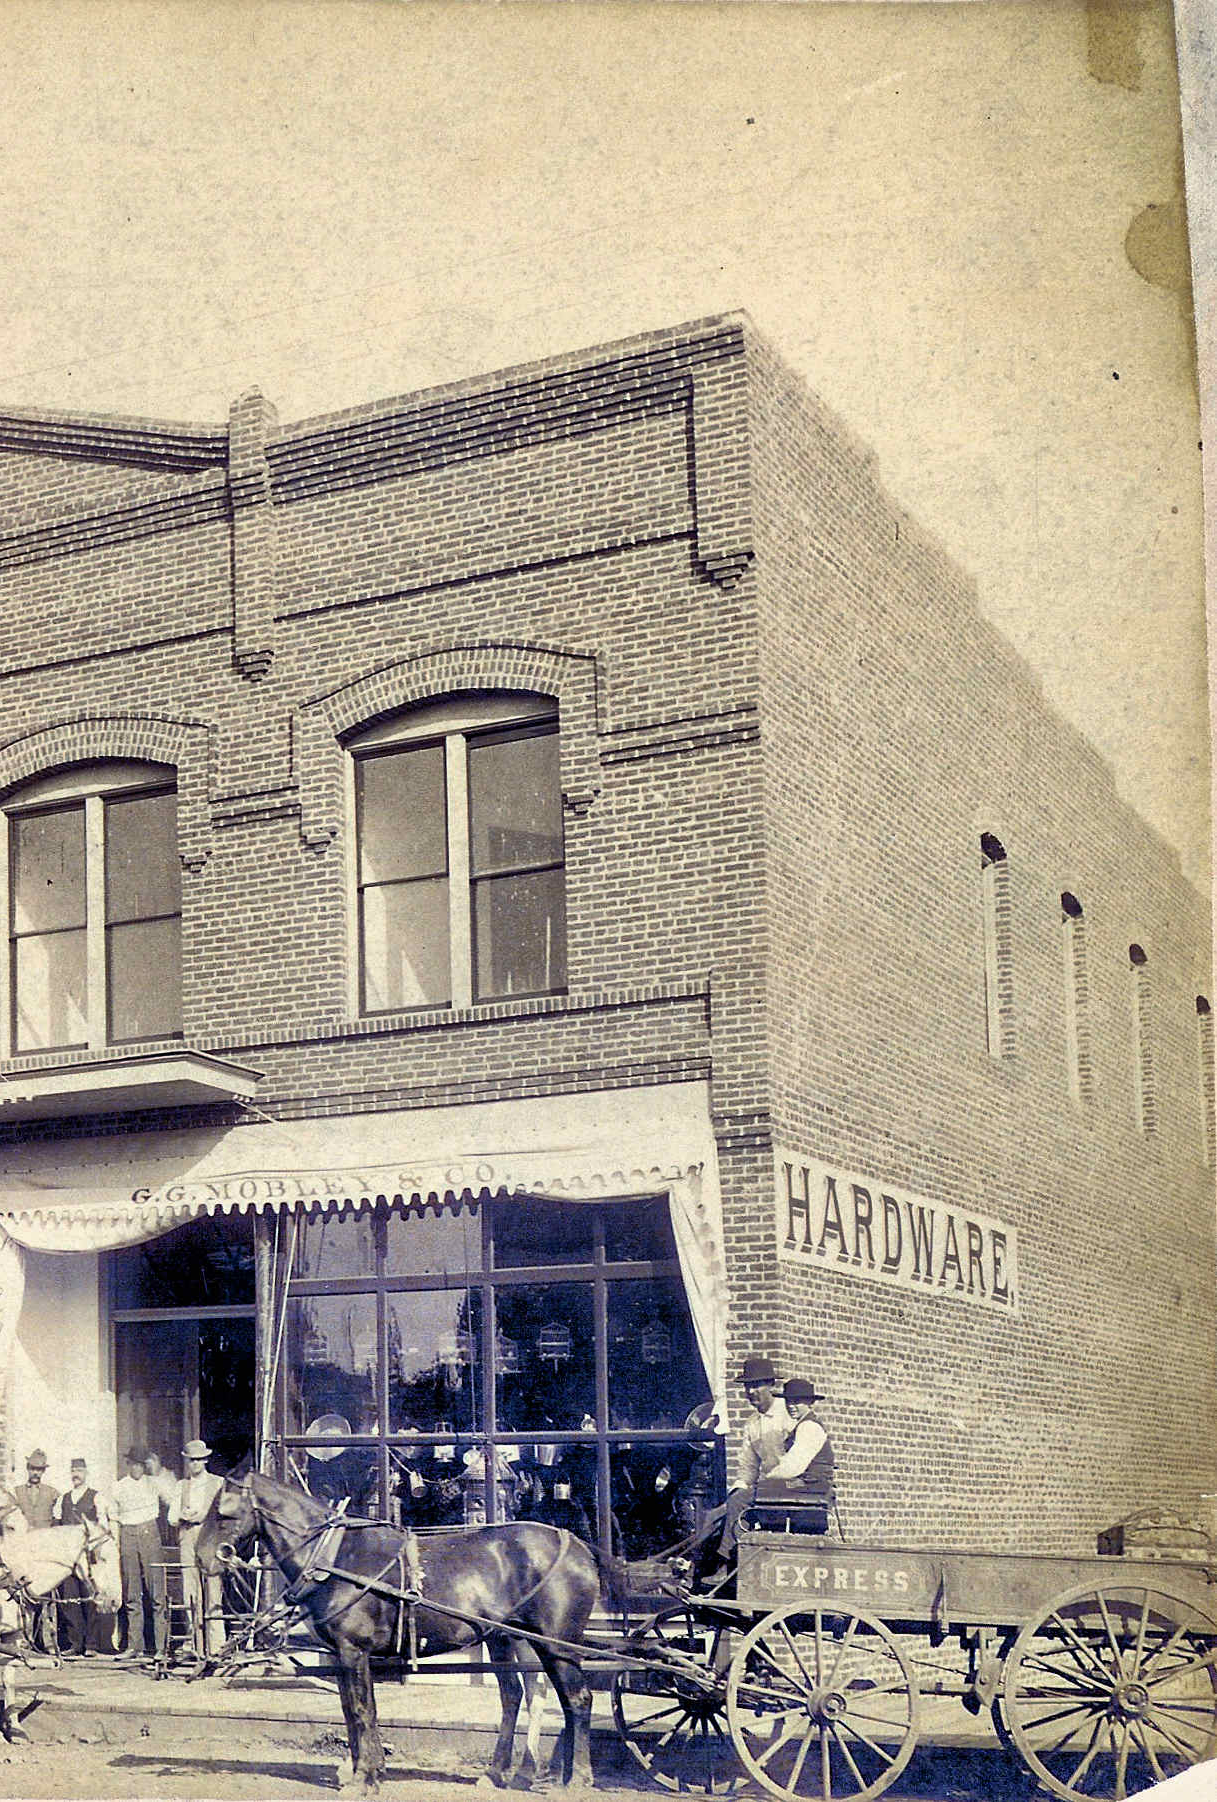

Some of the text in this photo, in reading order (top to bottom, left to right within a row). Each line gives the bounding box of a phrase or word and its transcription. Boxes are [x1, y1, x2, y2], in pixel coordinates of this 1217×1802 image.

[207, 1174, 374, 1200] MOBLEY
[399, 1171, 423, 1190] &
[775, 1565, 909, 1592] EXPRESS
